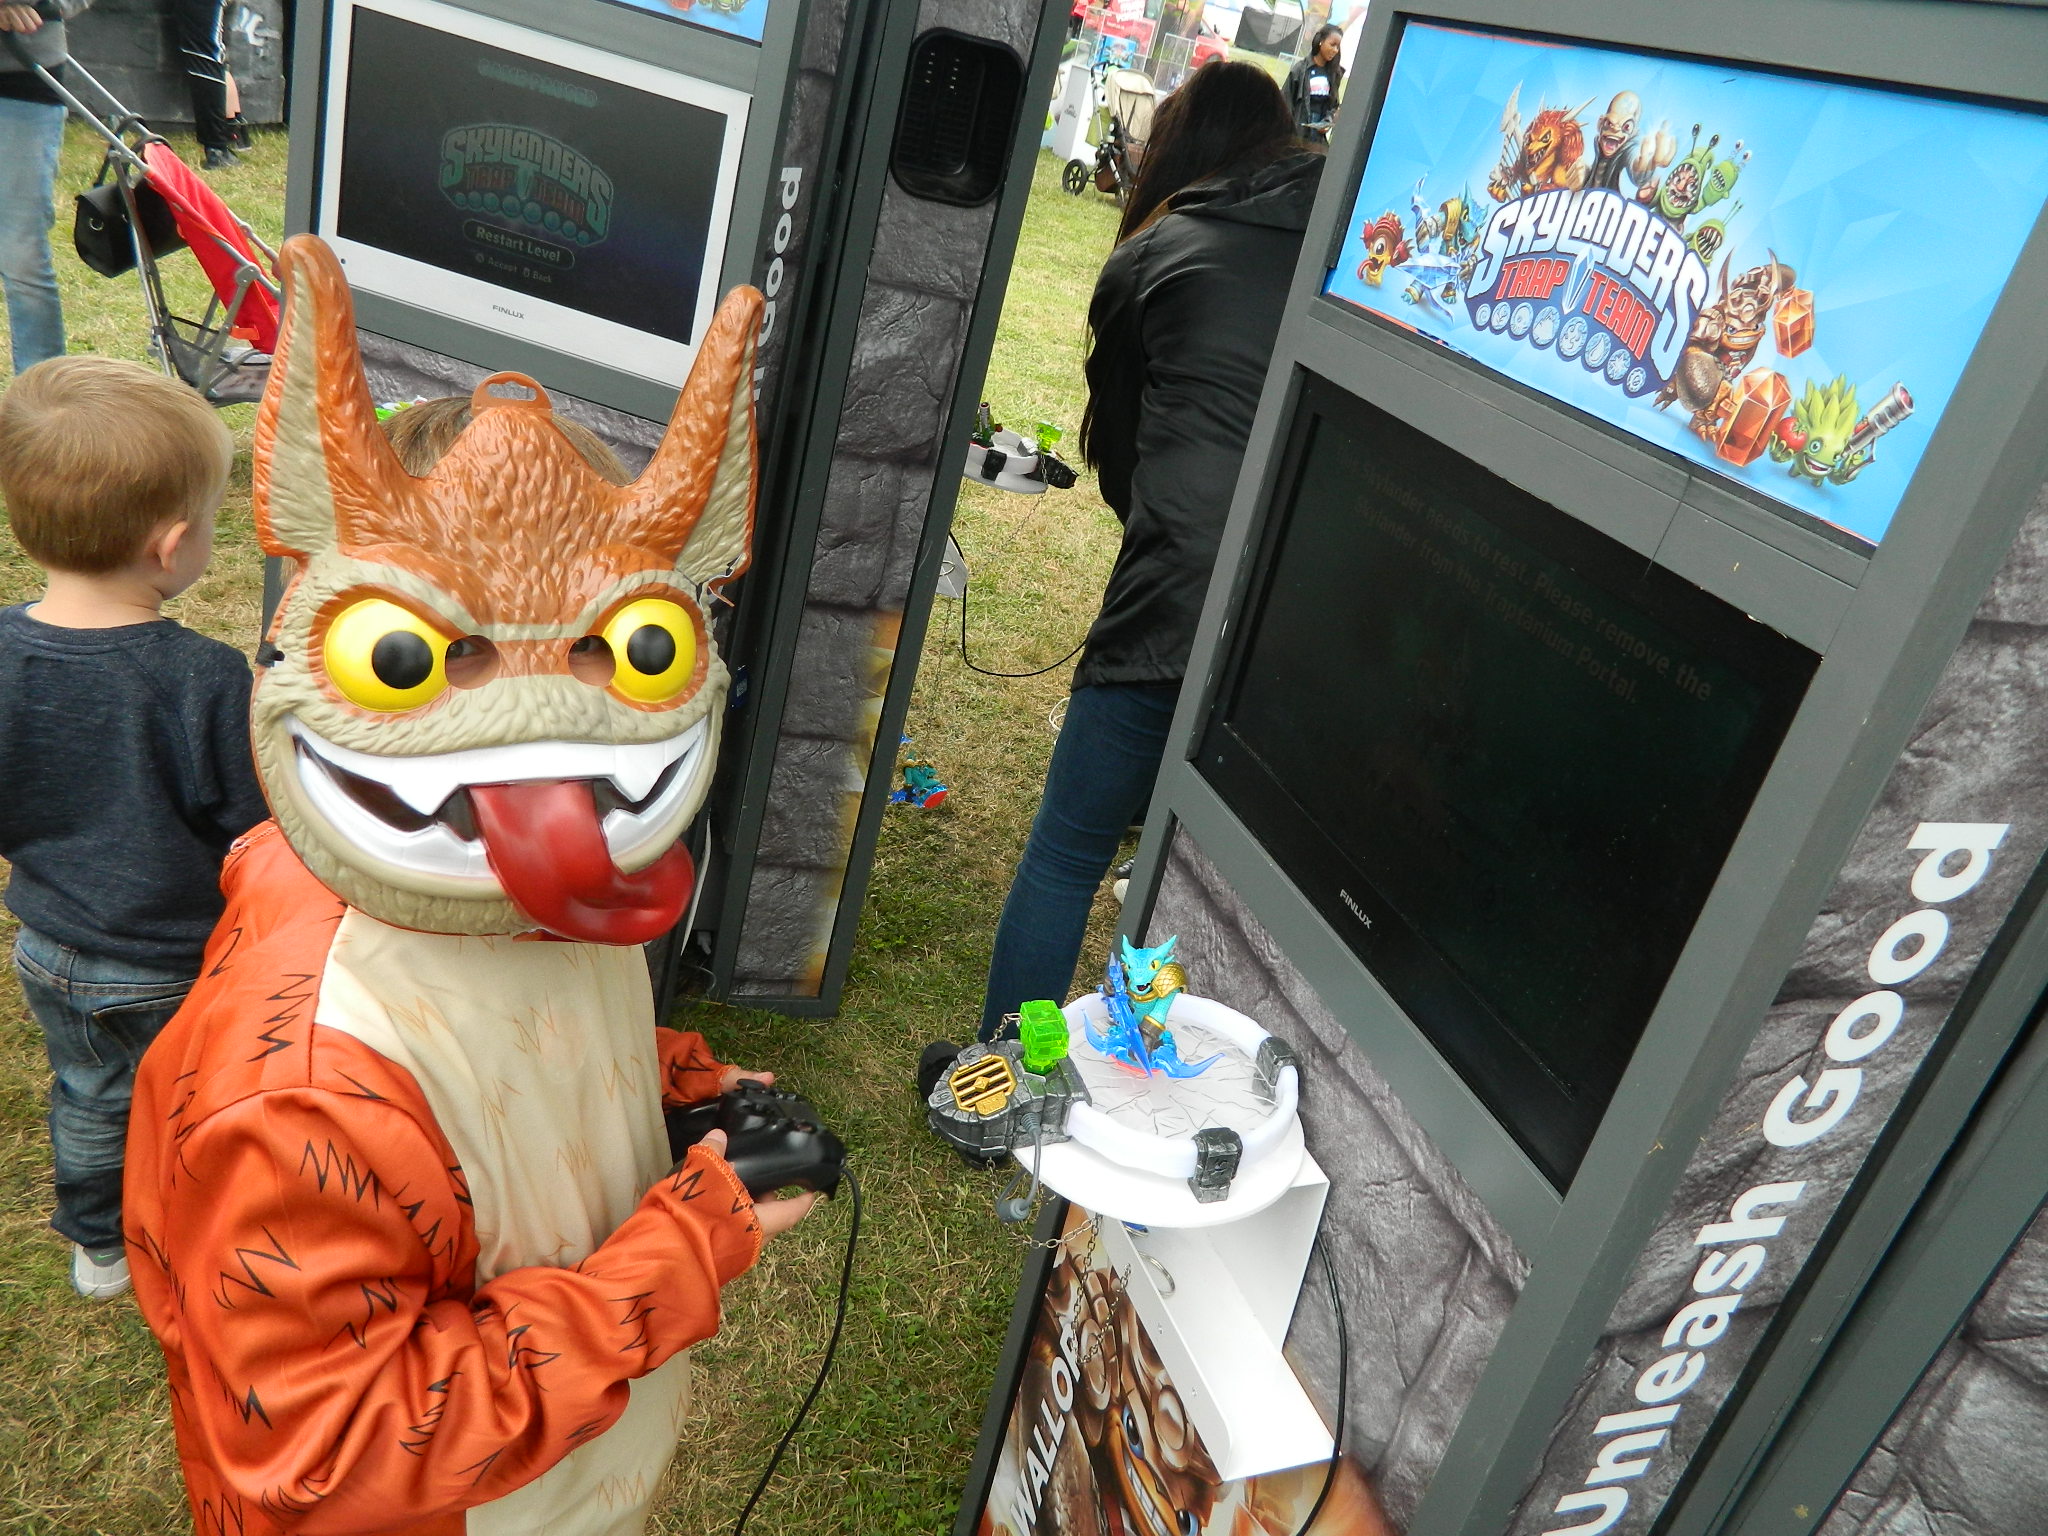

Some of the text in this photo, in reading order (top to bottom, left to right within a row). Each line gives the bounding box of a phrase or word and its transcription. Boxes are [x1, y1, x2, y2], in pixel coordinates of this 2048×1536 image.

[443, 127, 611, 236] SKYLANDERS
[476, 225, 561, 263] Restart Level
[1466, 189, 1709, 382] SKYLANDERS
[491, 304, 525, 320] FINLUX
[1495, 257, 1657, 360] TRAP TEAM
[1418, 538, 1455, 576] from
[1455, 560, 1481, 595] the
[1486, 581, 1575, 659] Traptanium
[1574, 643, 1639, 706] Portal.
[1426, 505, 1471, 546] needs
[1472, 532, 1491, 558] to
[1532, 570, 1594, 625] Please
[1594, 616, 1671, 676] remove
[1674, 661, 1714, 702] the
[1338, 888, 1373, 930] FINLUX
[1761, 821, 2010, 1148] Good
